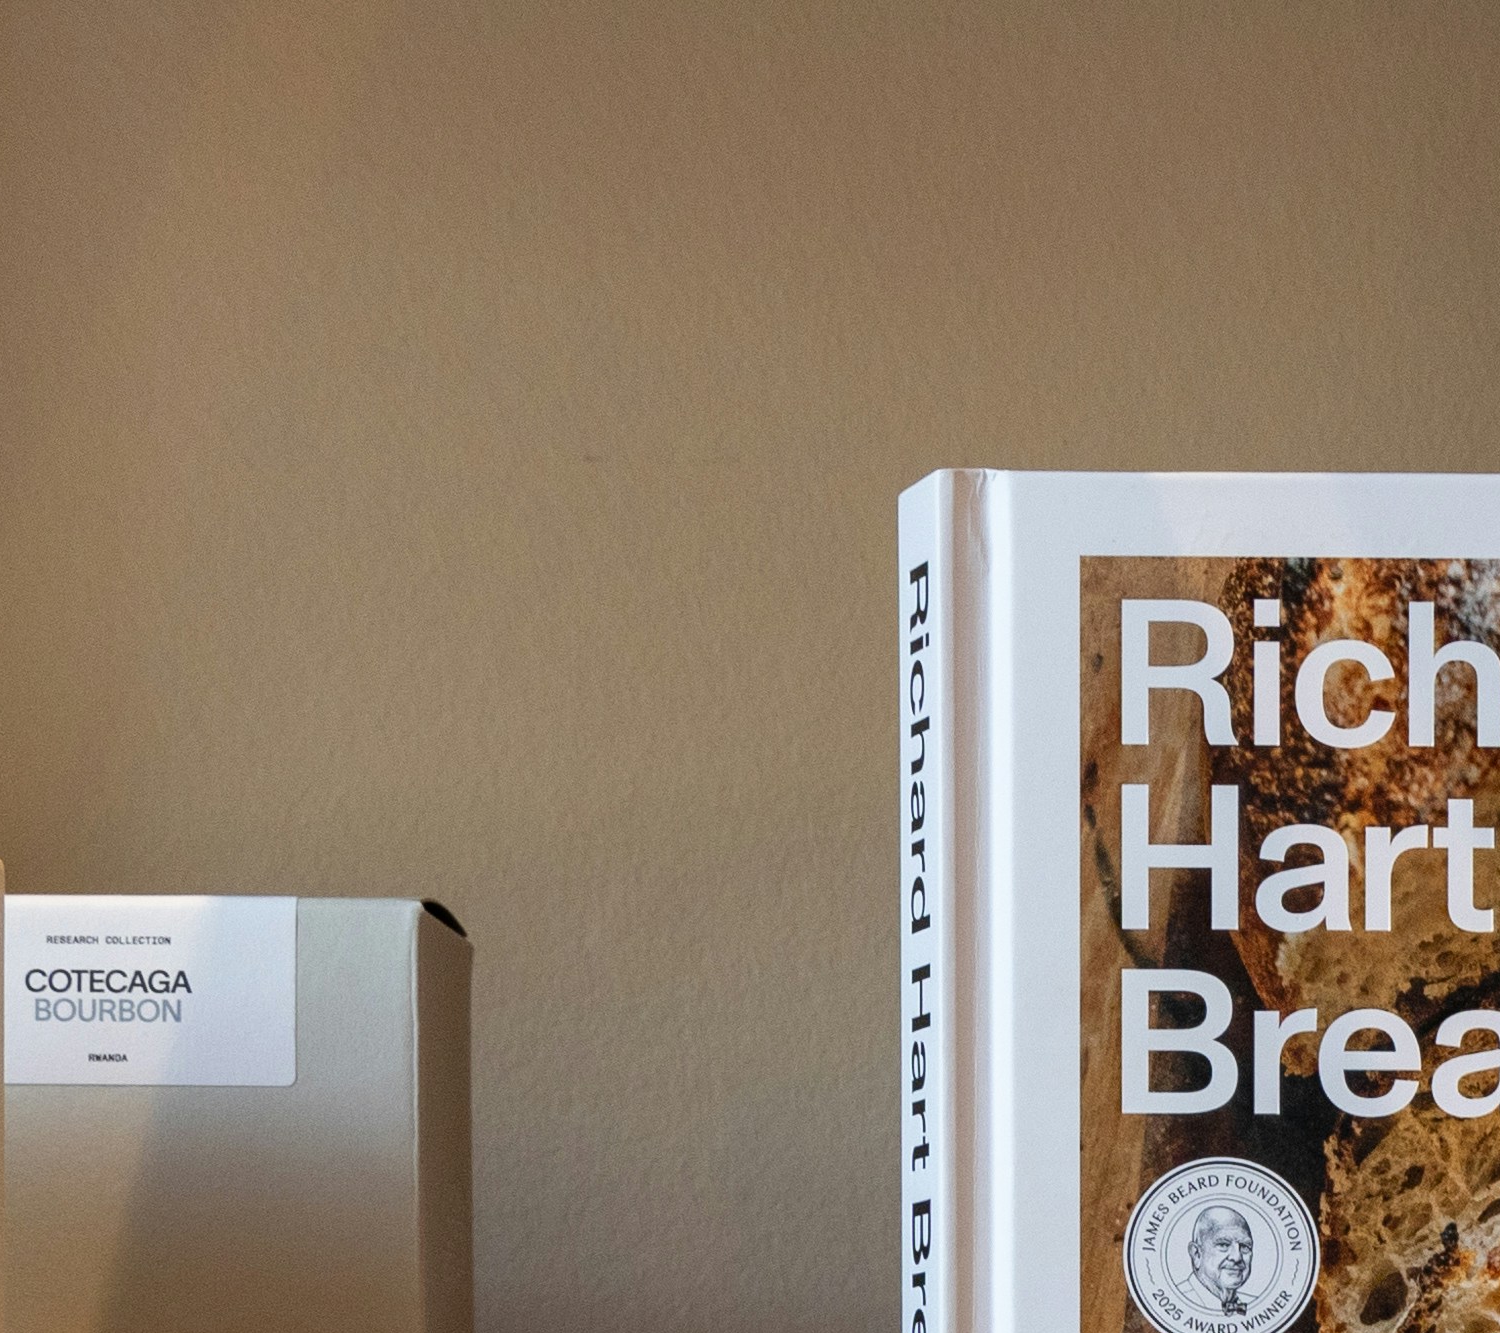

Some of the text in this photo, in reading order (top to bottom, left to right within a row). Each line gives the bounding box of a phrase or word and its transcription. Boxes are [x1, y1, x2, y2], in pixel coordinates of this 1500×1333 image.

[909, 561, 931, 934] Richard
[1121, 783, 1496, 934] Hart
[46, 935, 172, 946] RESEARCH COLLECTION
[24, 968, 193, 994] COTECAGA
[34, 997, 182, 1023] BOURBON
[911, 963, 931, 1172] Hart
[1142, 1174, 1303, 1252] JAMES BEARD FOUNDATION
[1152, 1288, 1184, 1322] 2025
[1241, 1290, 1293, 1333] WINNER
